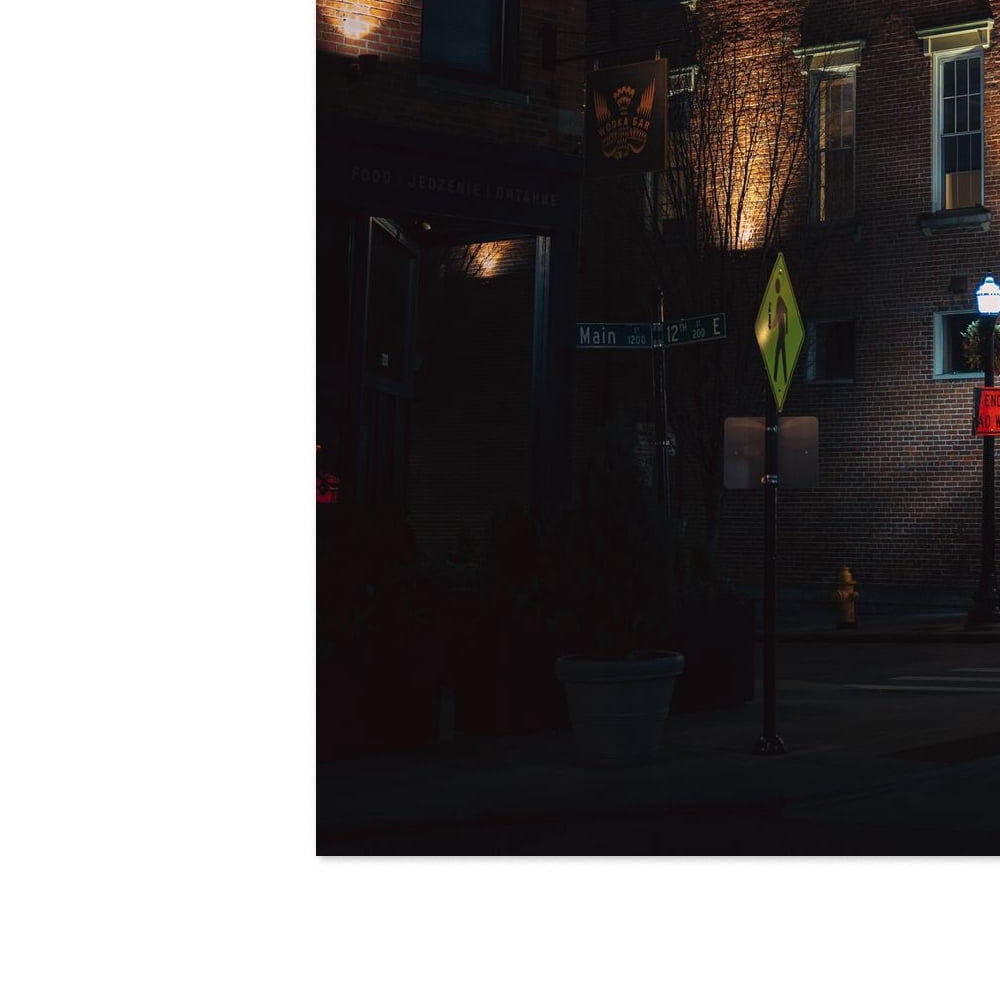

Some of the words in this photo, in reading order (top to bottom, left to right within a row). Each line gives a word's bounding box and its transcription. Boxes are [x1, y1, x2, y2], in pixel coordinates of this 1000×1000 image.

[351, 167, 393, 185] FOOD
[692, 328, 705, 339] 200
[713, 317, 721, 336] E
[579, 327, 616, 345] Main
[627, 335, 646, 345] 1200
